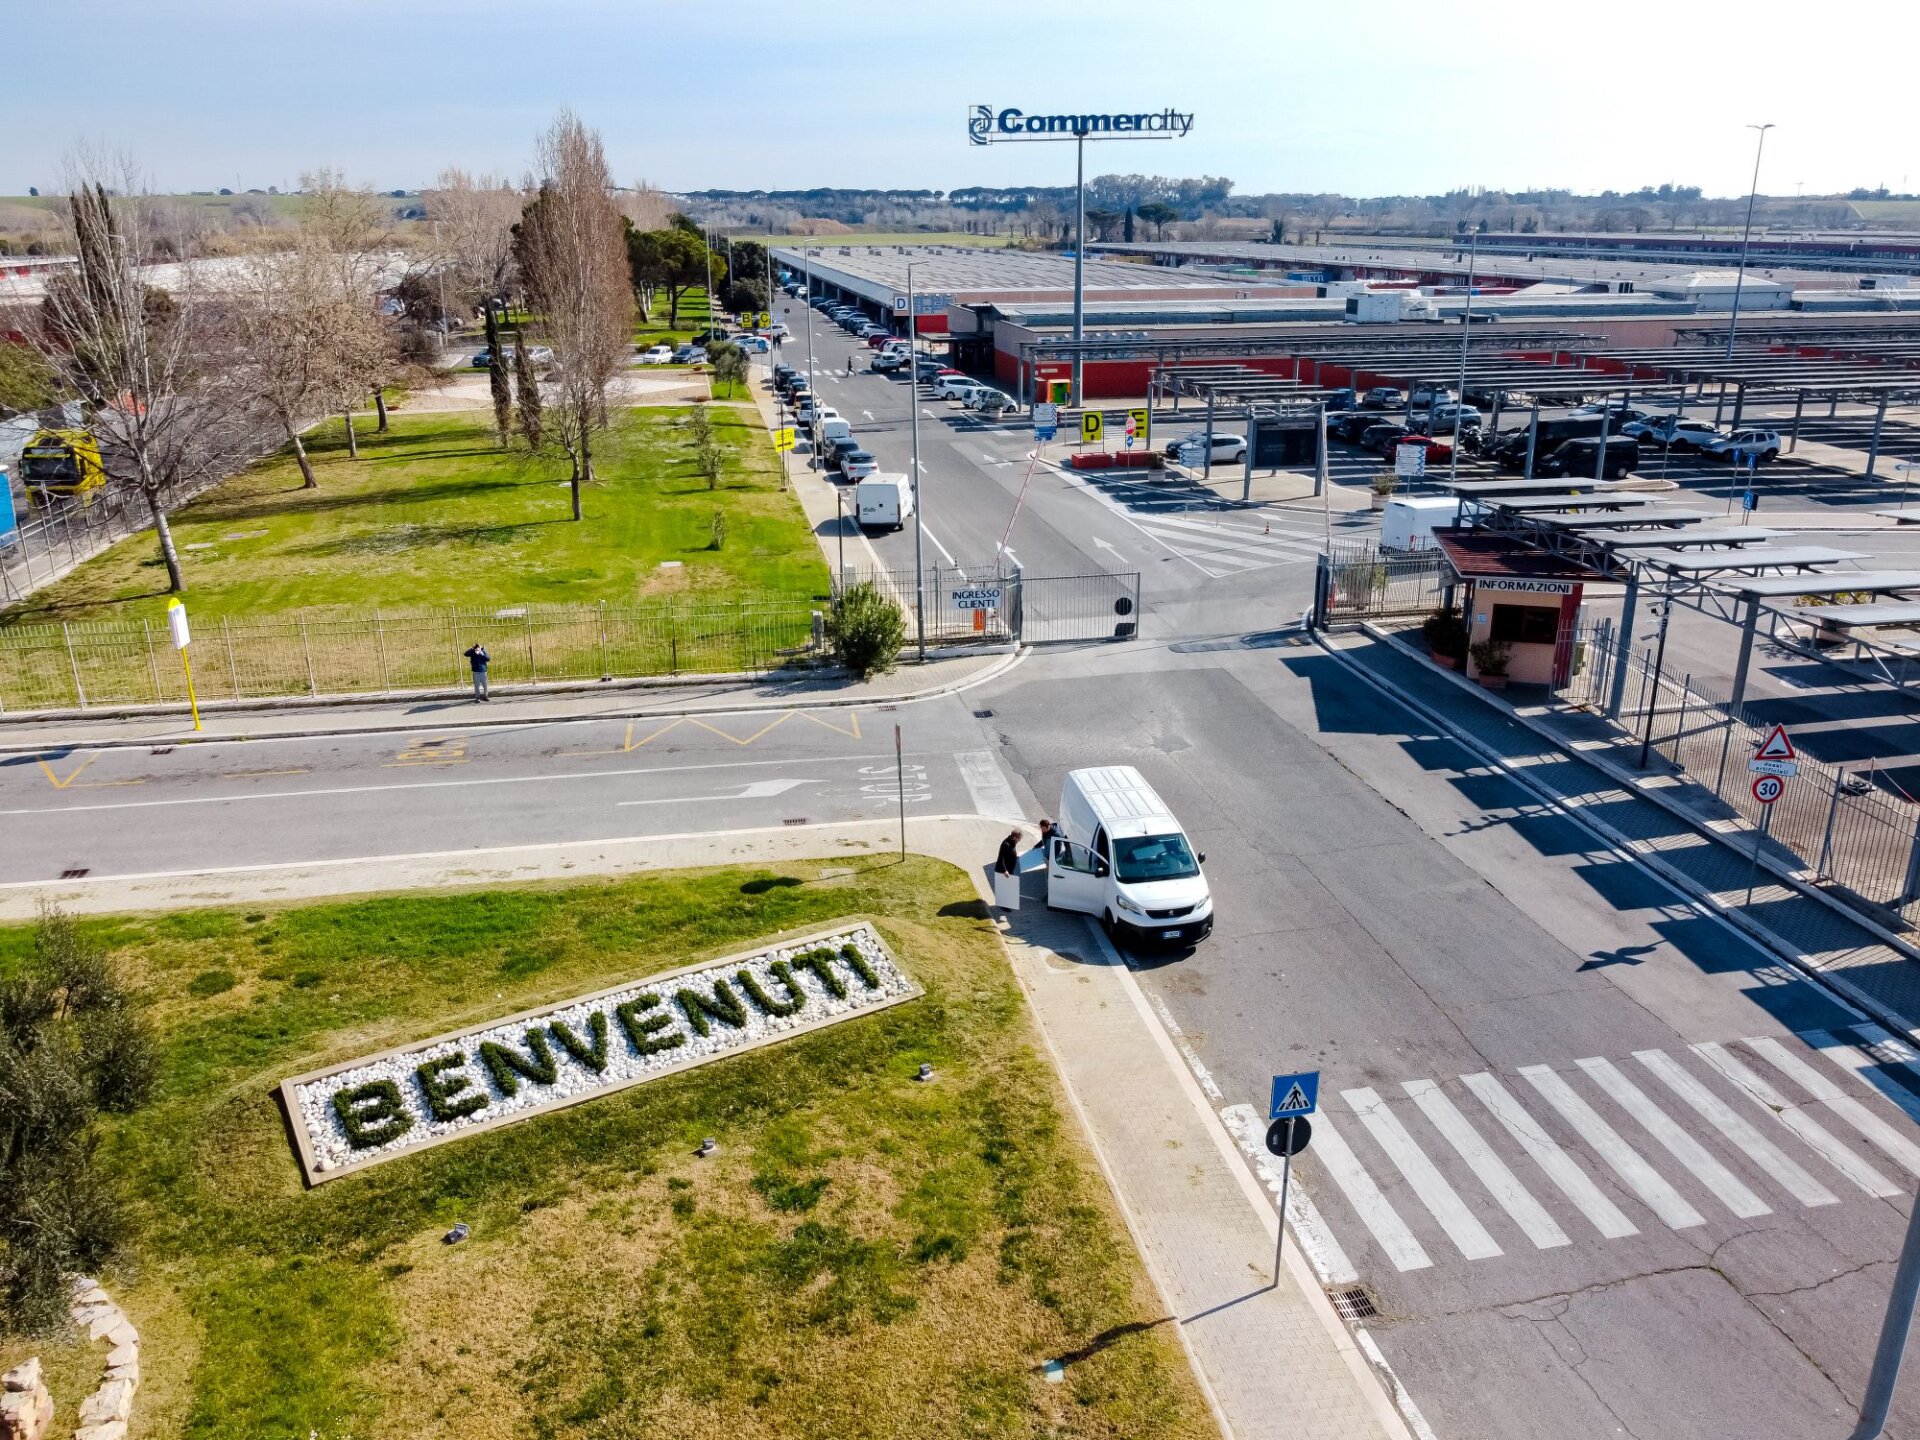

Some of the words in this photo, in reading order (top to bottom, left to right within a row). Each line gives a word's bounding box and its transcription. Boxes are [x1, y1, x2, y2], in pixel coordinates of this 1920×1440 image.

[998, 107, 1194, 138] Commercity
[897, 298, 906, 309] D
[742, 313, 751, 323] B
[760, 313, 769, 323] C
[1085, 414, 1100, 433] D
[1131, 411, 1145, 430] E
[1479, 579, 1570, 593] INFORMAZIONI
[952, 589, 1000, 600] INGRESSO
[958, 599, 995, 609] CLIENTI
[857, 764, 932, 802] STOP
[1760, 782, 1778, 796] 30
[333, 943, 881, 1149] BENVENUTI
